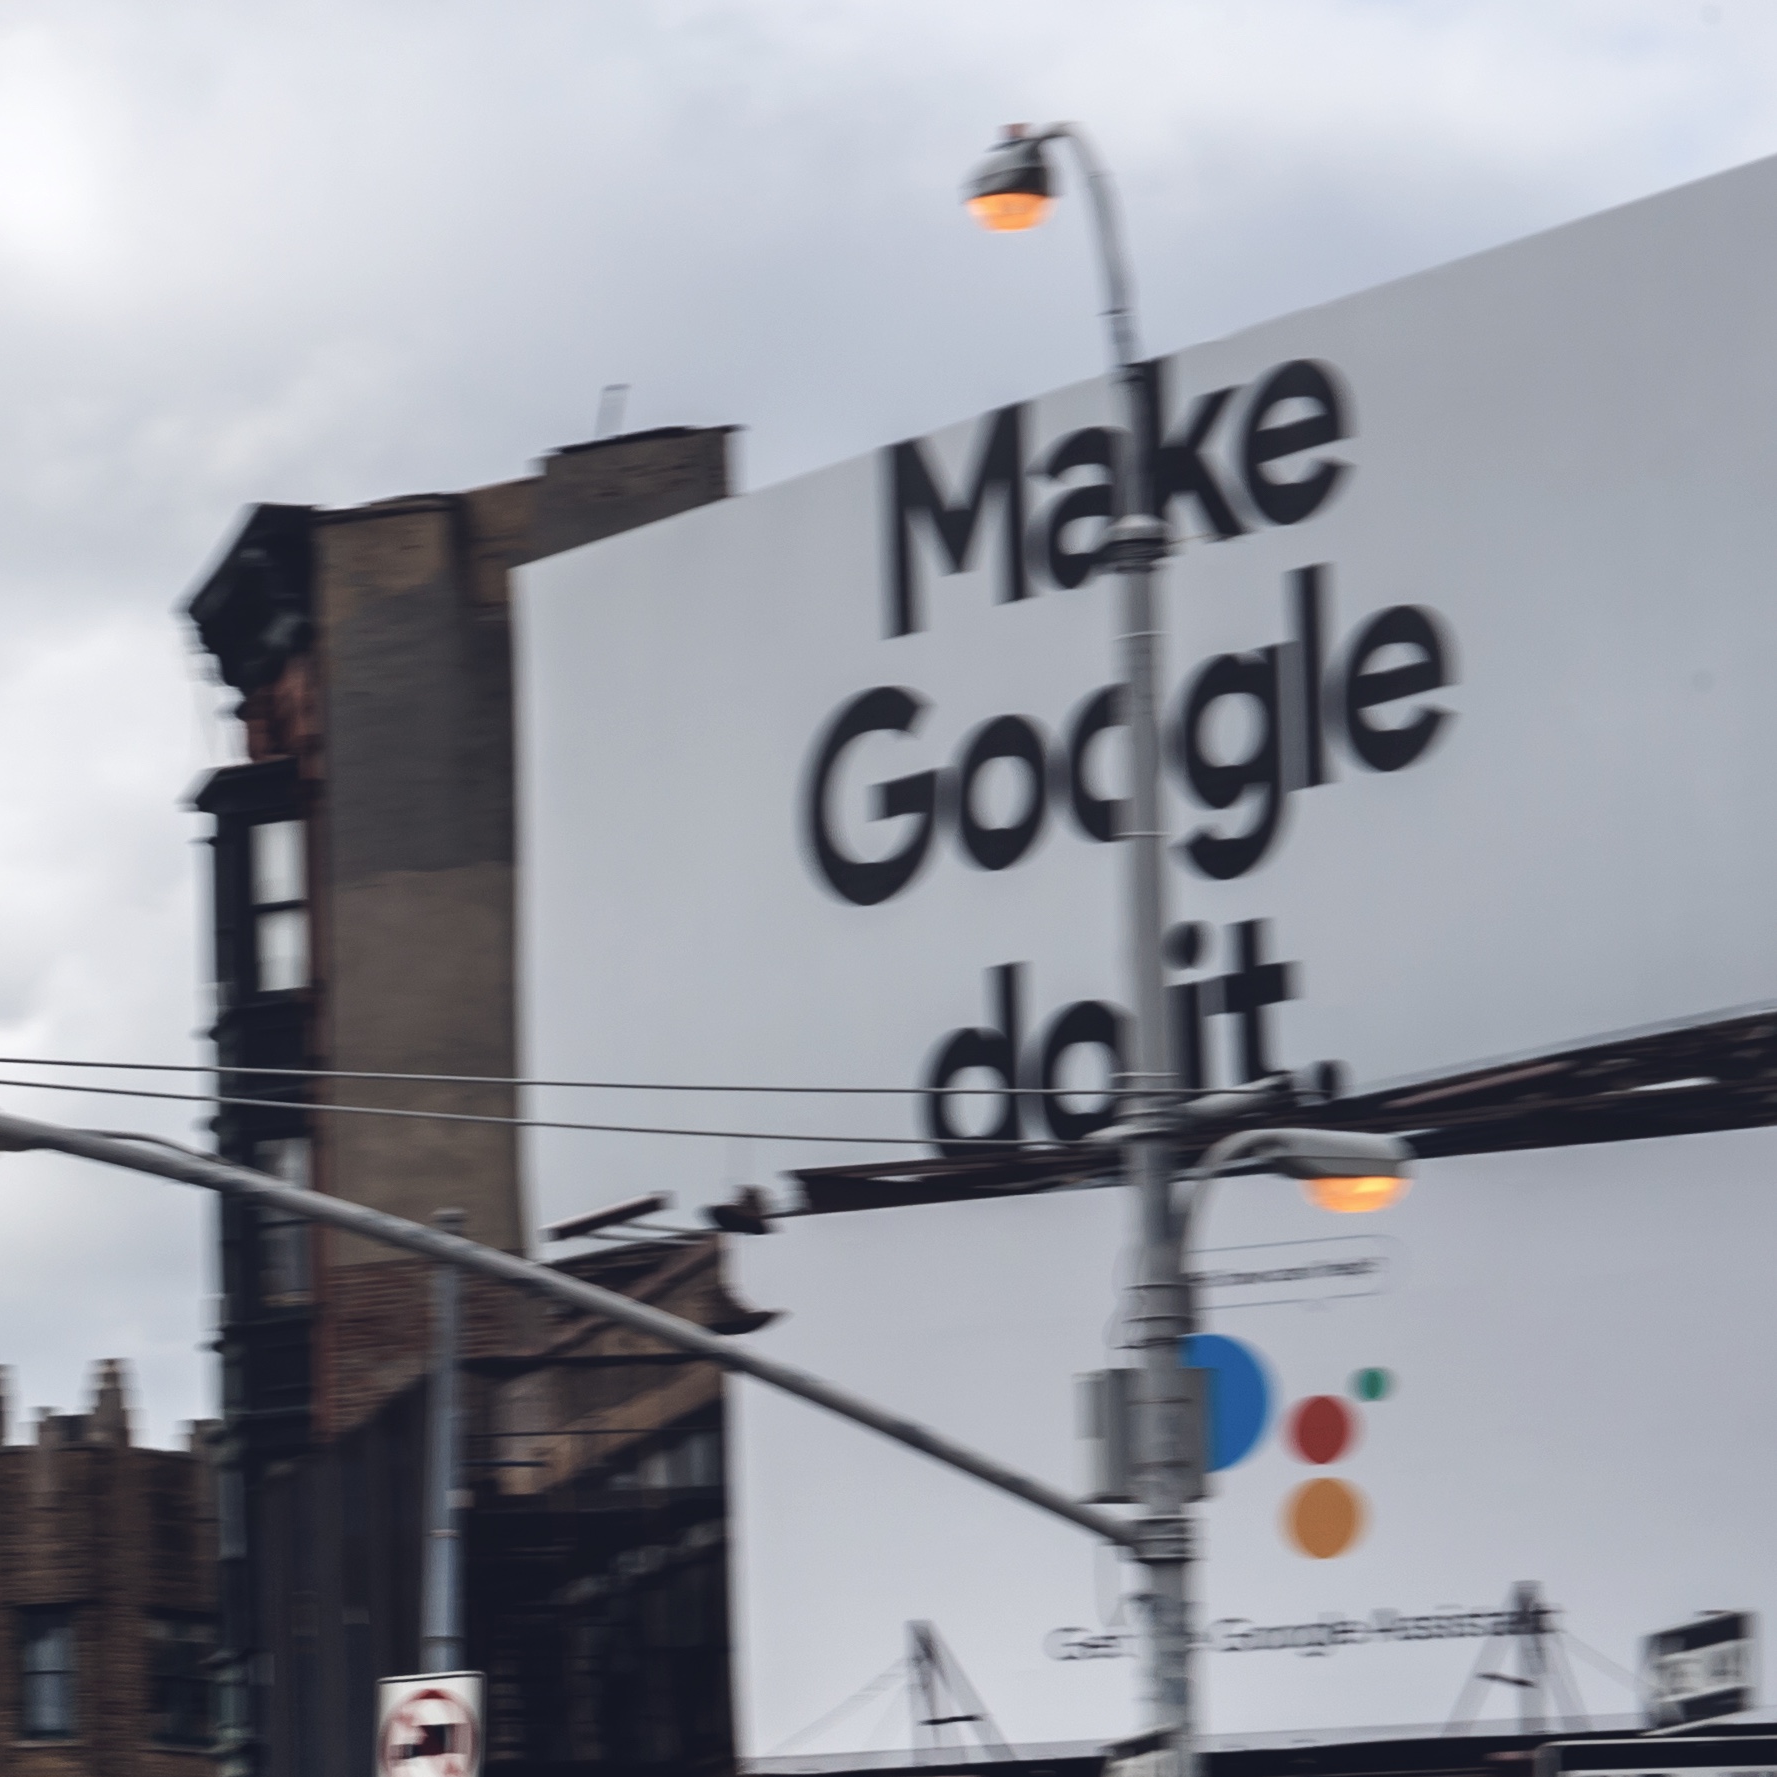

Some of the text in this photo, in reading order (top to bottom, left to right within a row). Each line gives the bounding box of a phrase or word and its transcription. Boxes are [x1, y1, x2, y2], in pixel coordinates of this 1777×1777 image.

[879, 355, 1357, 640] Make
[801, 560, 1460, 906] Google
[921, 960, 1130, 1160] do
